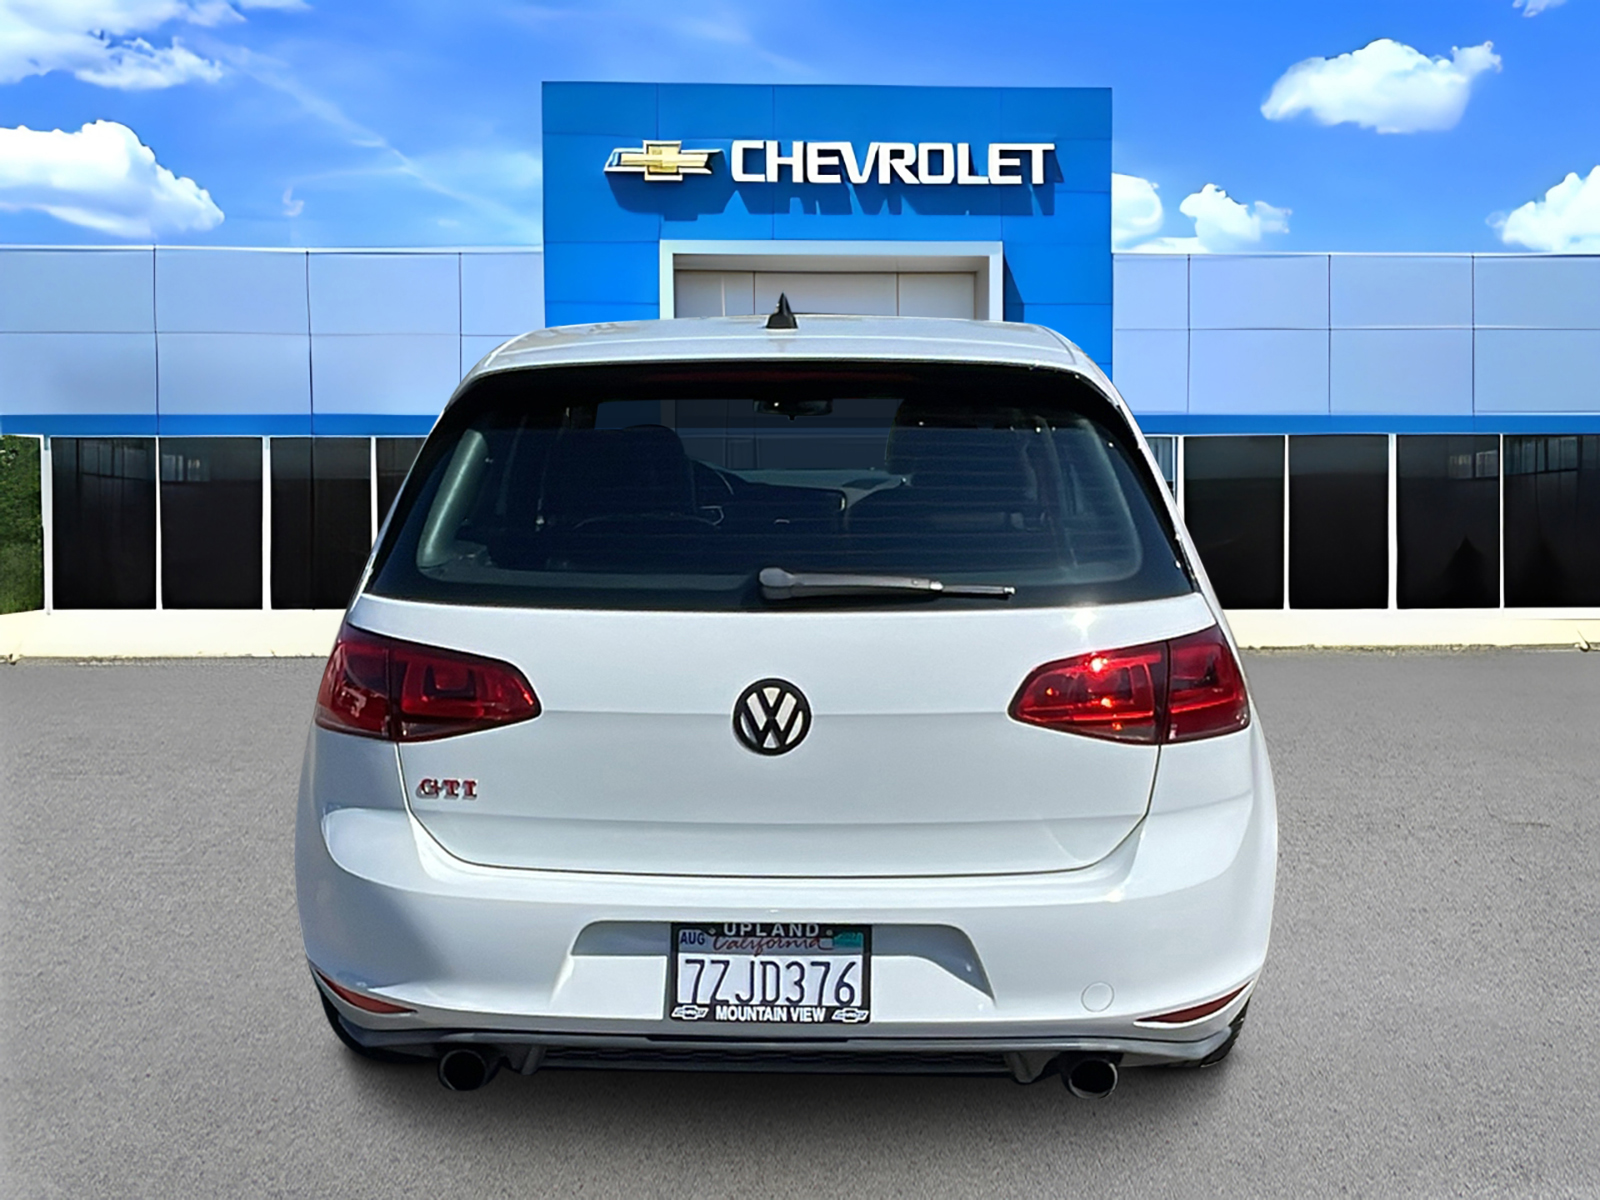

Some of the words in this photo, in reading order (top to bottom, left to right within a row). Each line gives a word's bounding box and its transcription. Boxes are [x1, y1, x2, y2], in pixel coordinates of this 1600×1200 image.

[731, 140, 1055, 184] CHEVROLET
[415, 777, 478, 800] GTI
[680, 931, 705, 945] AUG
[724, 923, 820, 936] UPLAND
[715, 1005, 788, 1022] MOUNTAIN
[791, 1007, 826, 1022] VIEW
